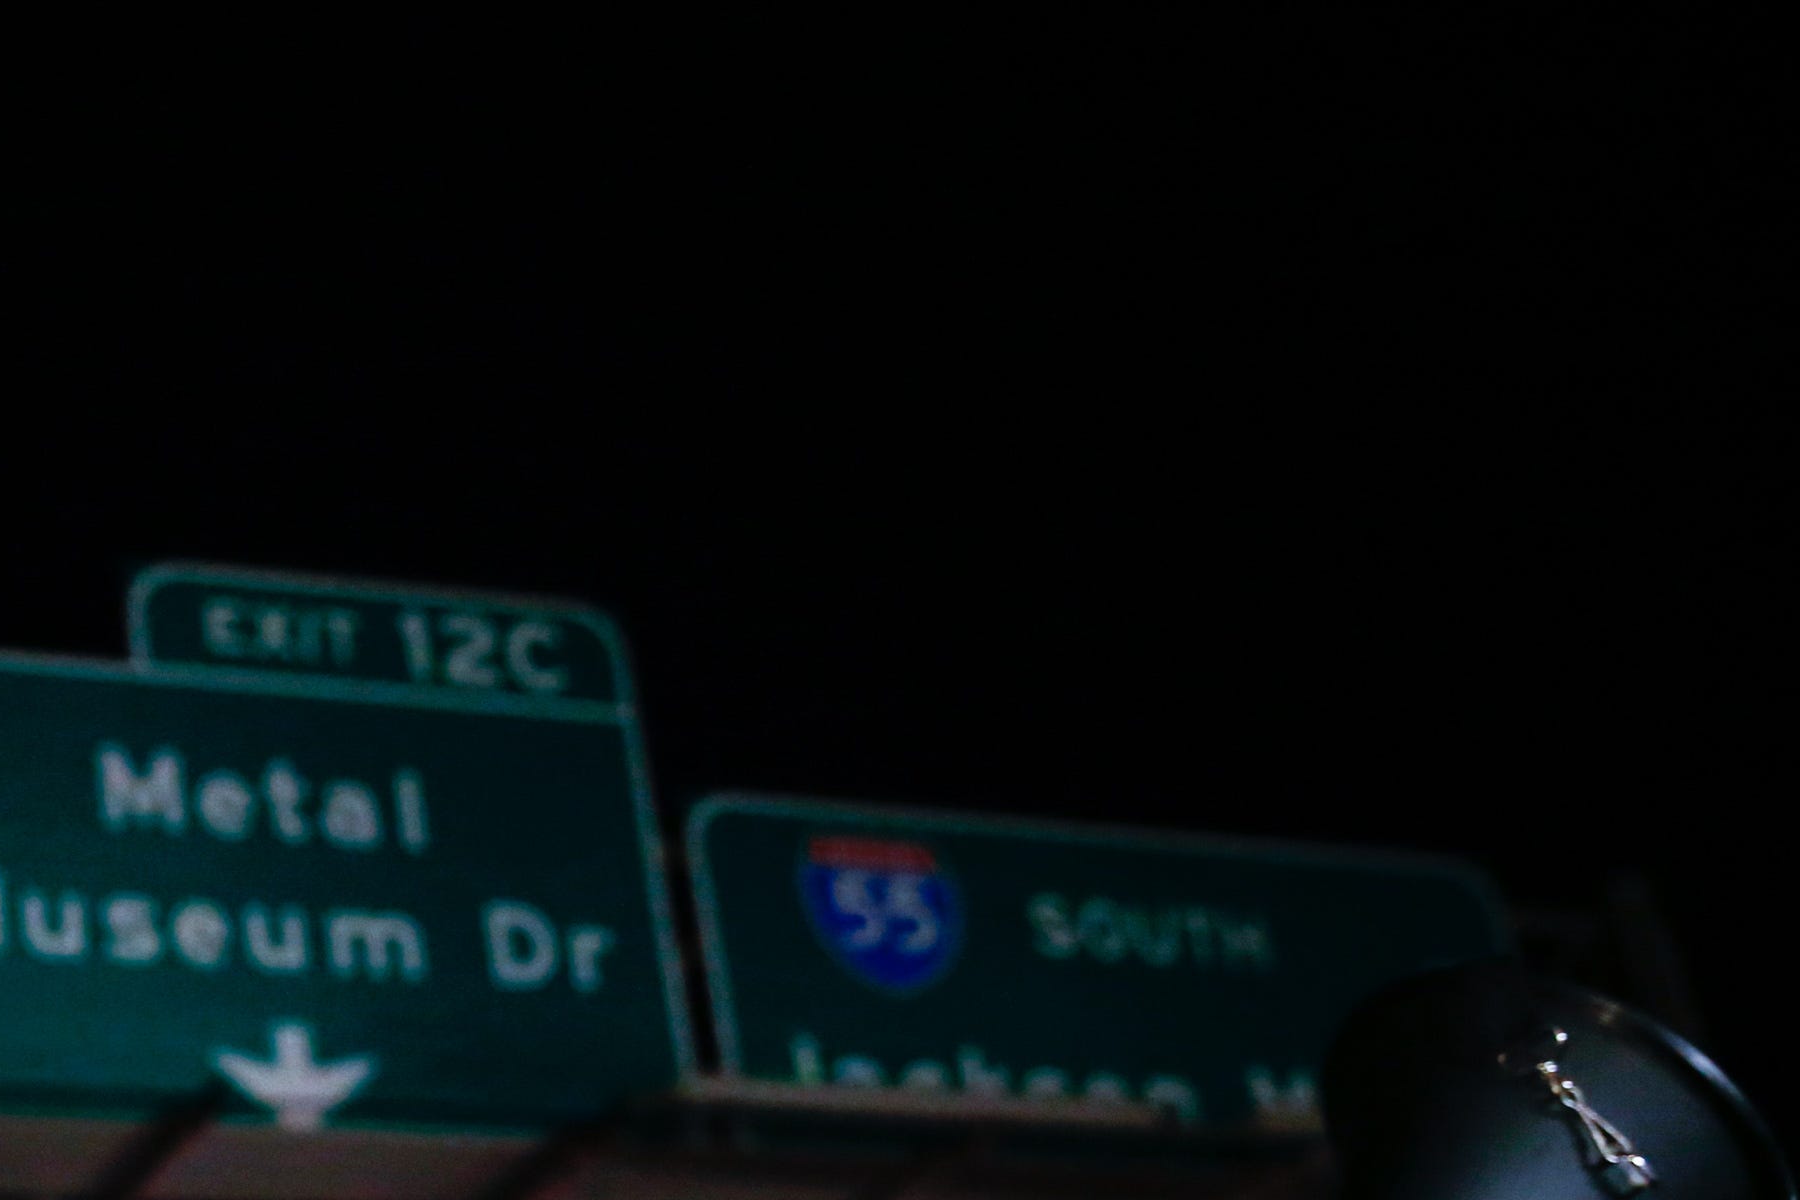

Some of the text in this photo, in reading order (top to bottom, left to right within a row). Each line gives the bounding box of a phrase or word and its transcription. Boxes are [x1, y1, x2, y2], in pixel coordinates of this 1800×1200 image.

[203, 601, 564, 694] EXIT 12C
[97, 744, 428, 852] Metal
[482, 898, 612, 990] Dr
[830, 862, 940, 958] 55
[1028, 892, 1274, 970] SOUTH
